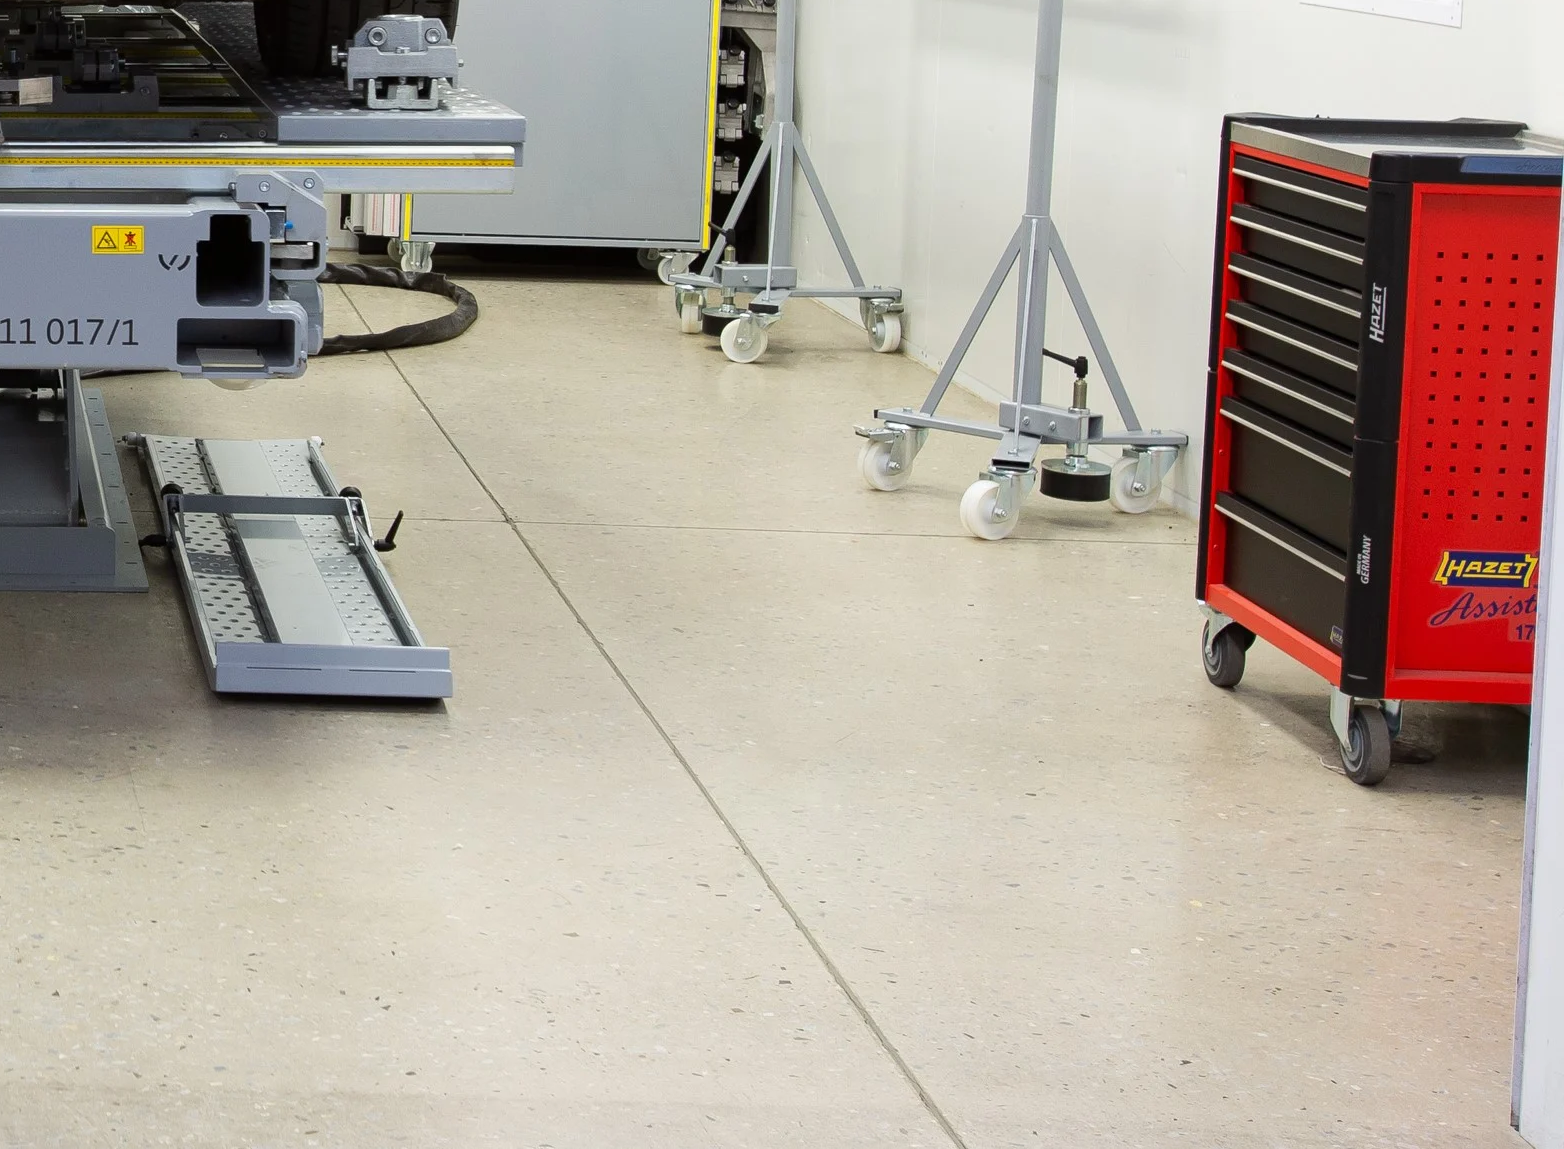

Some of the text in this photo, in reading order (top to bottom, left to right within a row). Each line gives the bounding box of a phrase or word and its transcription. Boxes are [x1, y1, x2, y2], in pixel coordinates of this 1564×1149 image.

[1369, 282, 1386, 344] HAZET
[46, 318, 139, 345] 017/1
[1360, 534, 1371, 584] GERMANY
[1445, 559, 1528, 578] HAZET
[1430, 592, 1537, 626] Assist
[1516, 624, 1535, 640] 17
